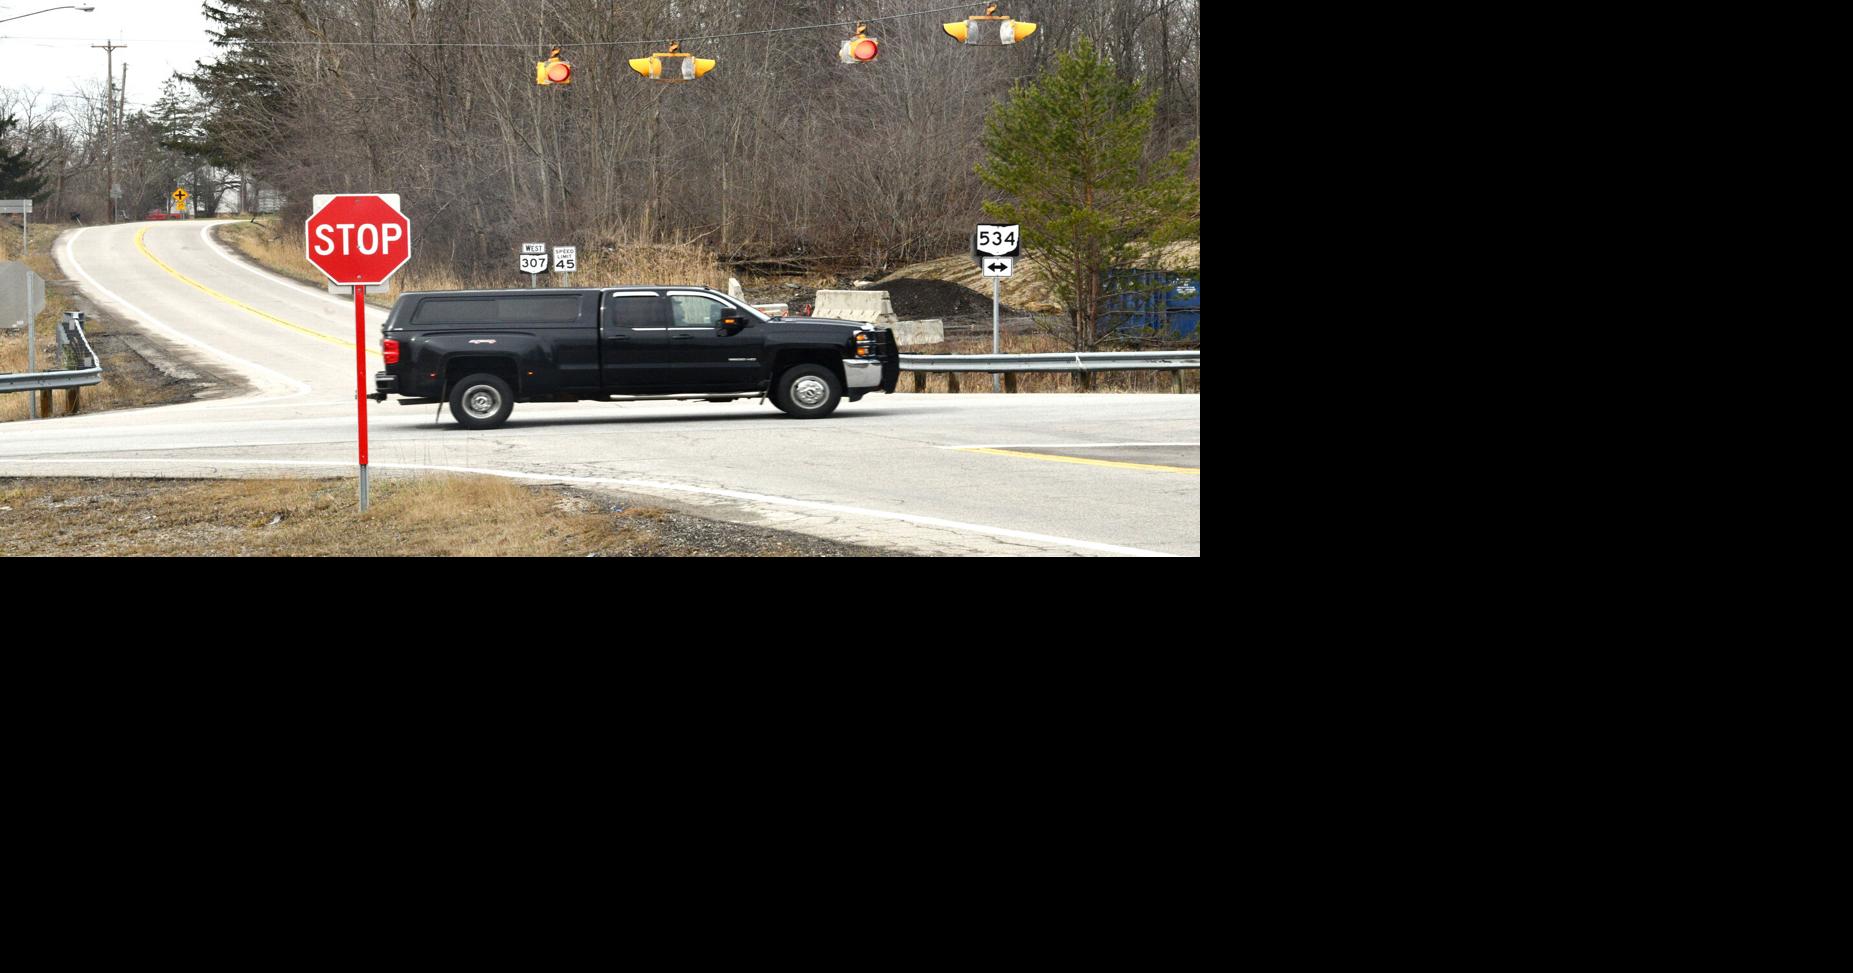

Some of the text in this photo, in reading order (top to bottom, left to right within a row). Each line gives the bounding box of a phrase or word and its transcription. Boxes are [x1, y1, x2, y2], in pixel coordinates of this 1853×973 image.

[314, 223, 403, 256] STOP
[979, 231, 1016, 246] 534
[521, 258, 546, 268] 307
[555, 259, 575, 269] 45
